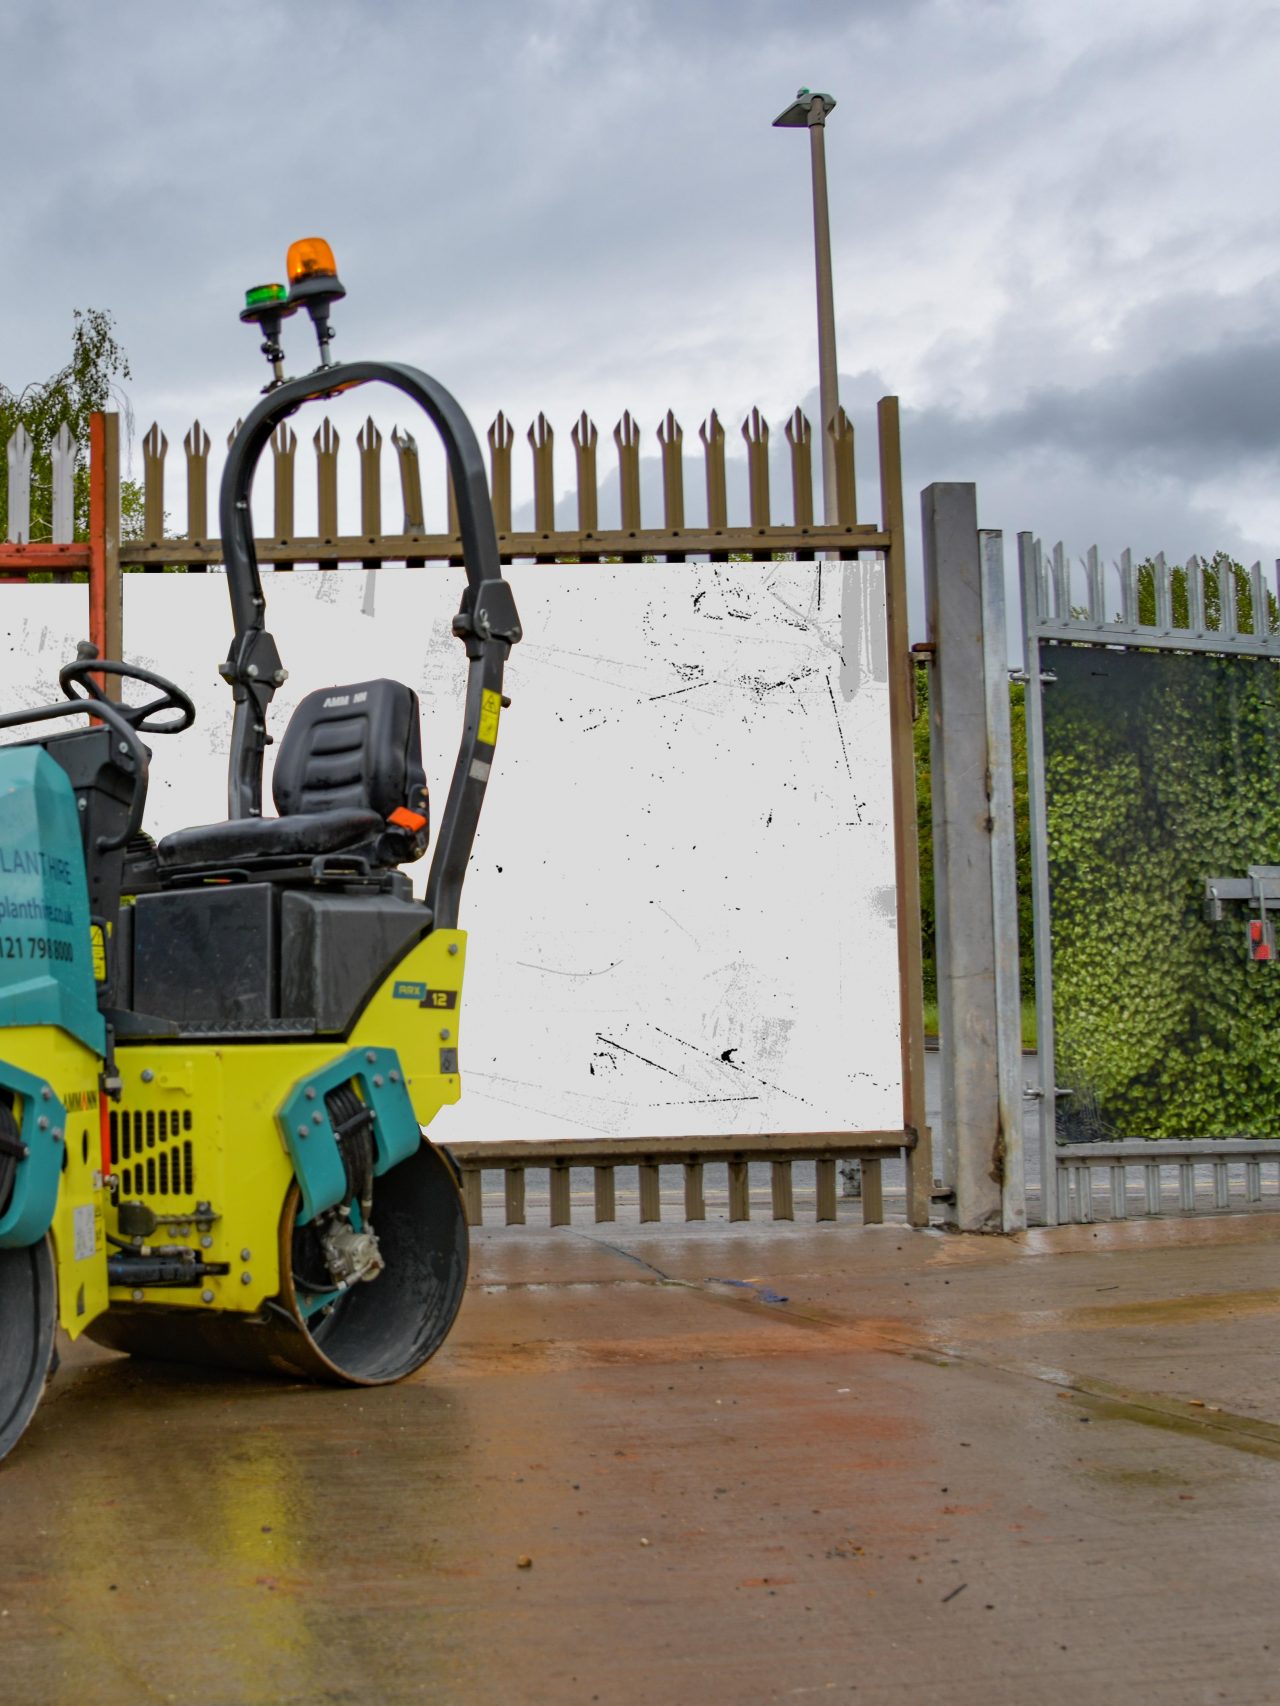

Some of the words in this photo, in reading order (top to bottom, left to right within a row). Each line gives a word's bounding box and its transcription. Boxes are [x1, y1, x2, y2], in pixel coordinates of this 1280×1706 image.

[322, 691, 368, 708] AMMNN
[28, 937, 52, 960] 798
[53, 939, 73, 963] 8000
[432, 992, 448, 1007] 12
